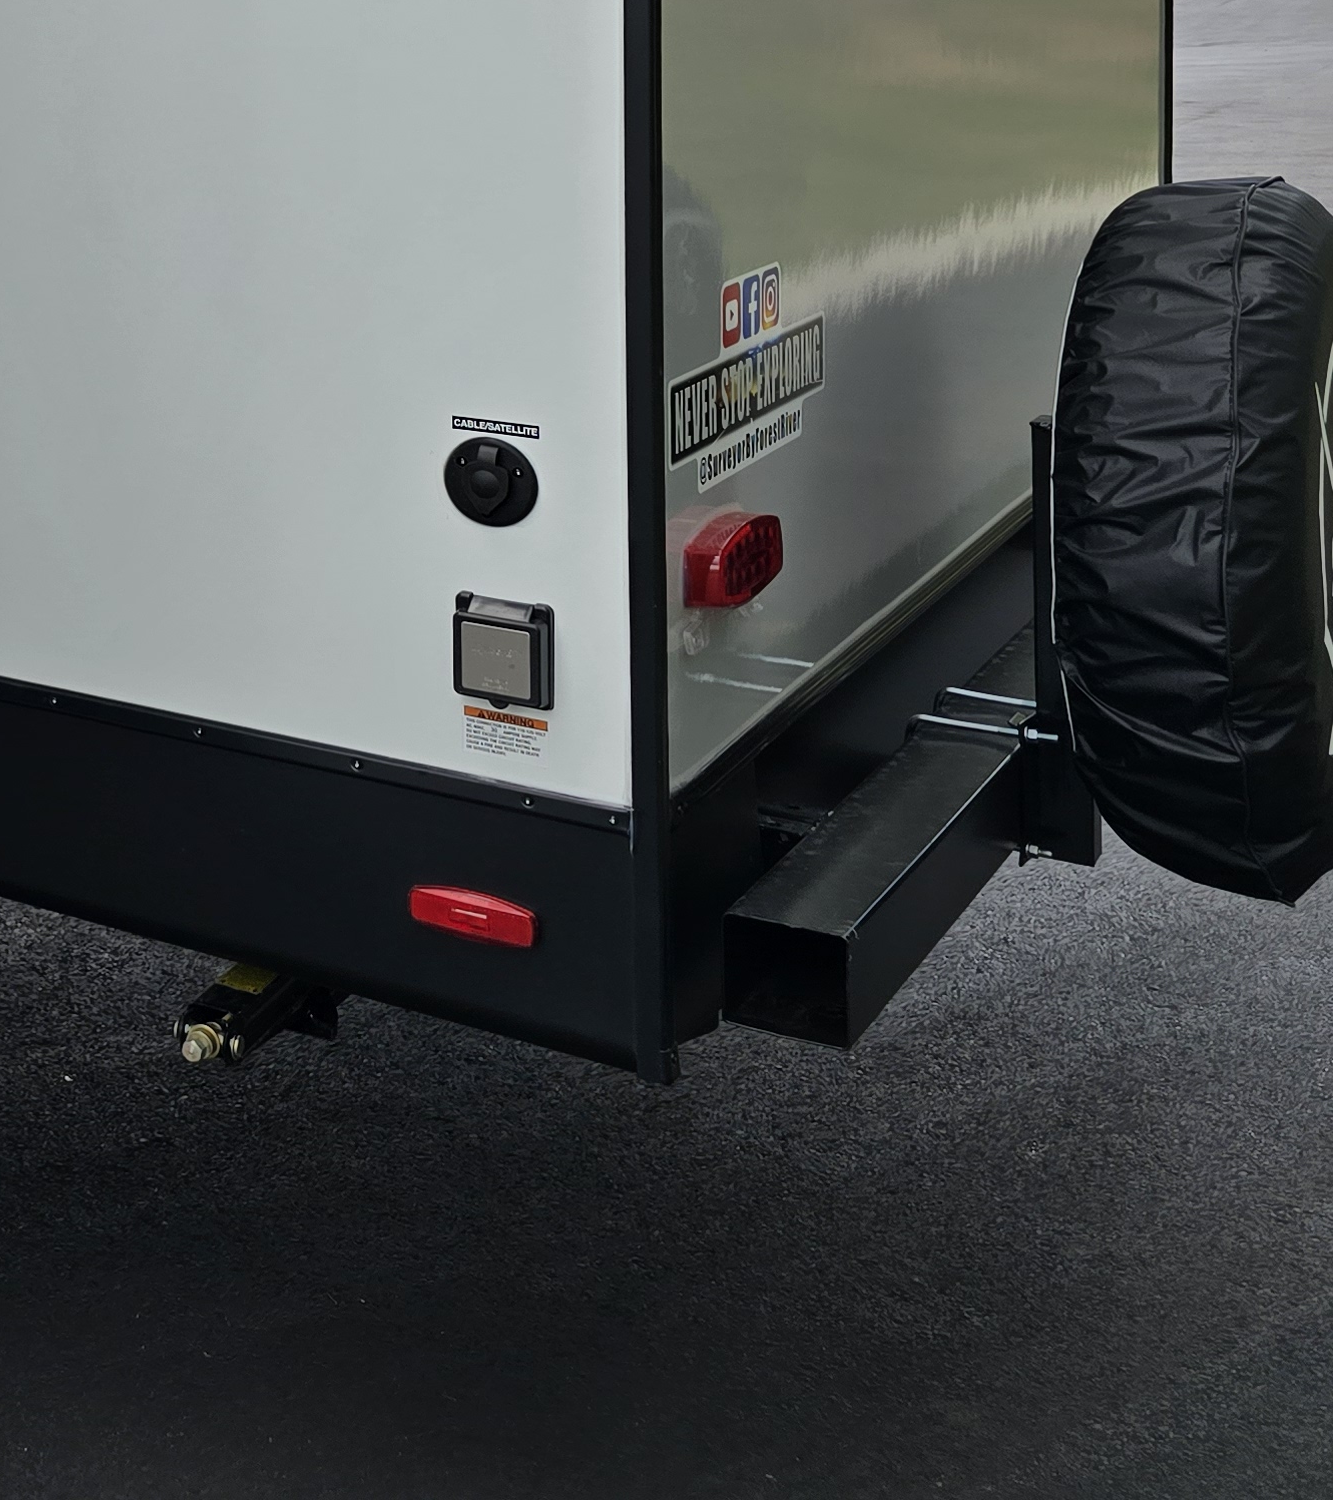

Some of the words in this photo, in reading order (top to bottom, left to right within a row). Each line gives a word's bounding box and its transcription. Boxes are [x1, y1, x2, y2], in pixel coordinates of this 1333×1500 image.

[675, 374, 718, 454] NEVER
[721, 357, 754, 430] STOP
[756, 324, 821, 411] EXPLORING
[453, 418, 539, 437] CABLE/SATELLITE
[486, 711, 535, 727] WARNING
